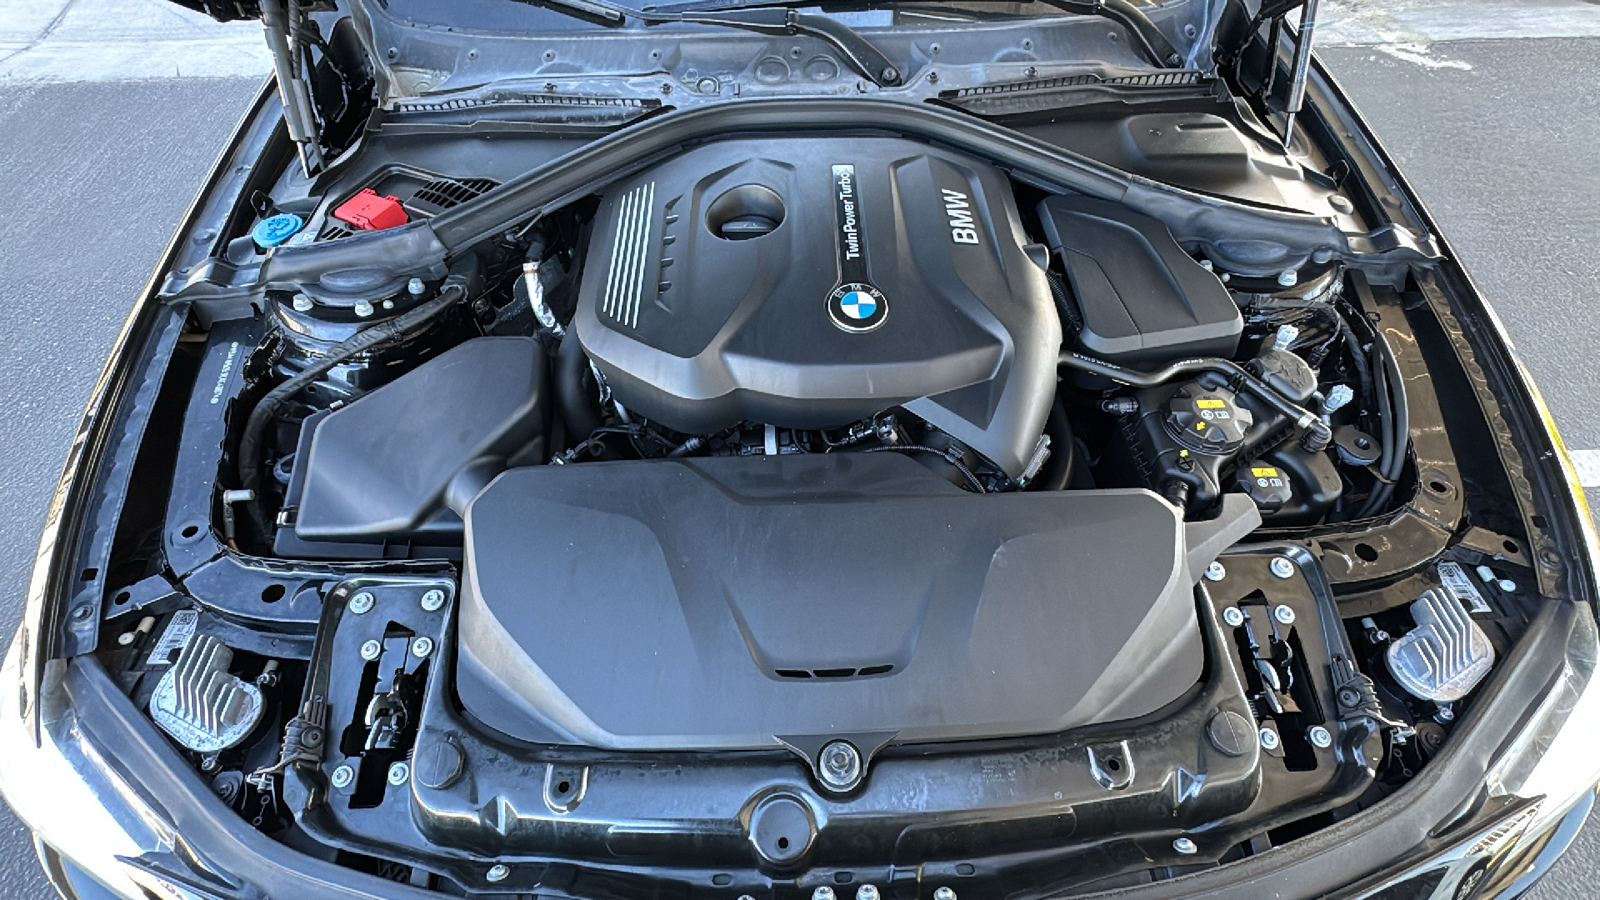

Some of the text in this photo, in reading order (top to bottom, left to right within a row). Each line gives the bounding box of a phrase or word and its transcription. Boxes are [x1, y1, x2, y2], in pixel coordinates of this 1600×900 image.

[838, 172, 860, 260] TwinPower Turbo
[941, 188, 979, 244] BMW
